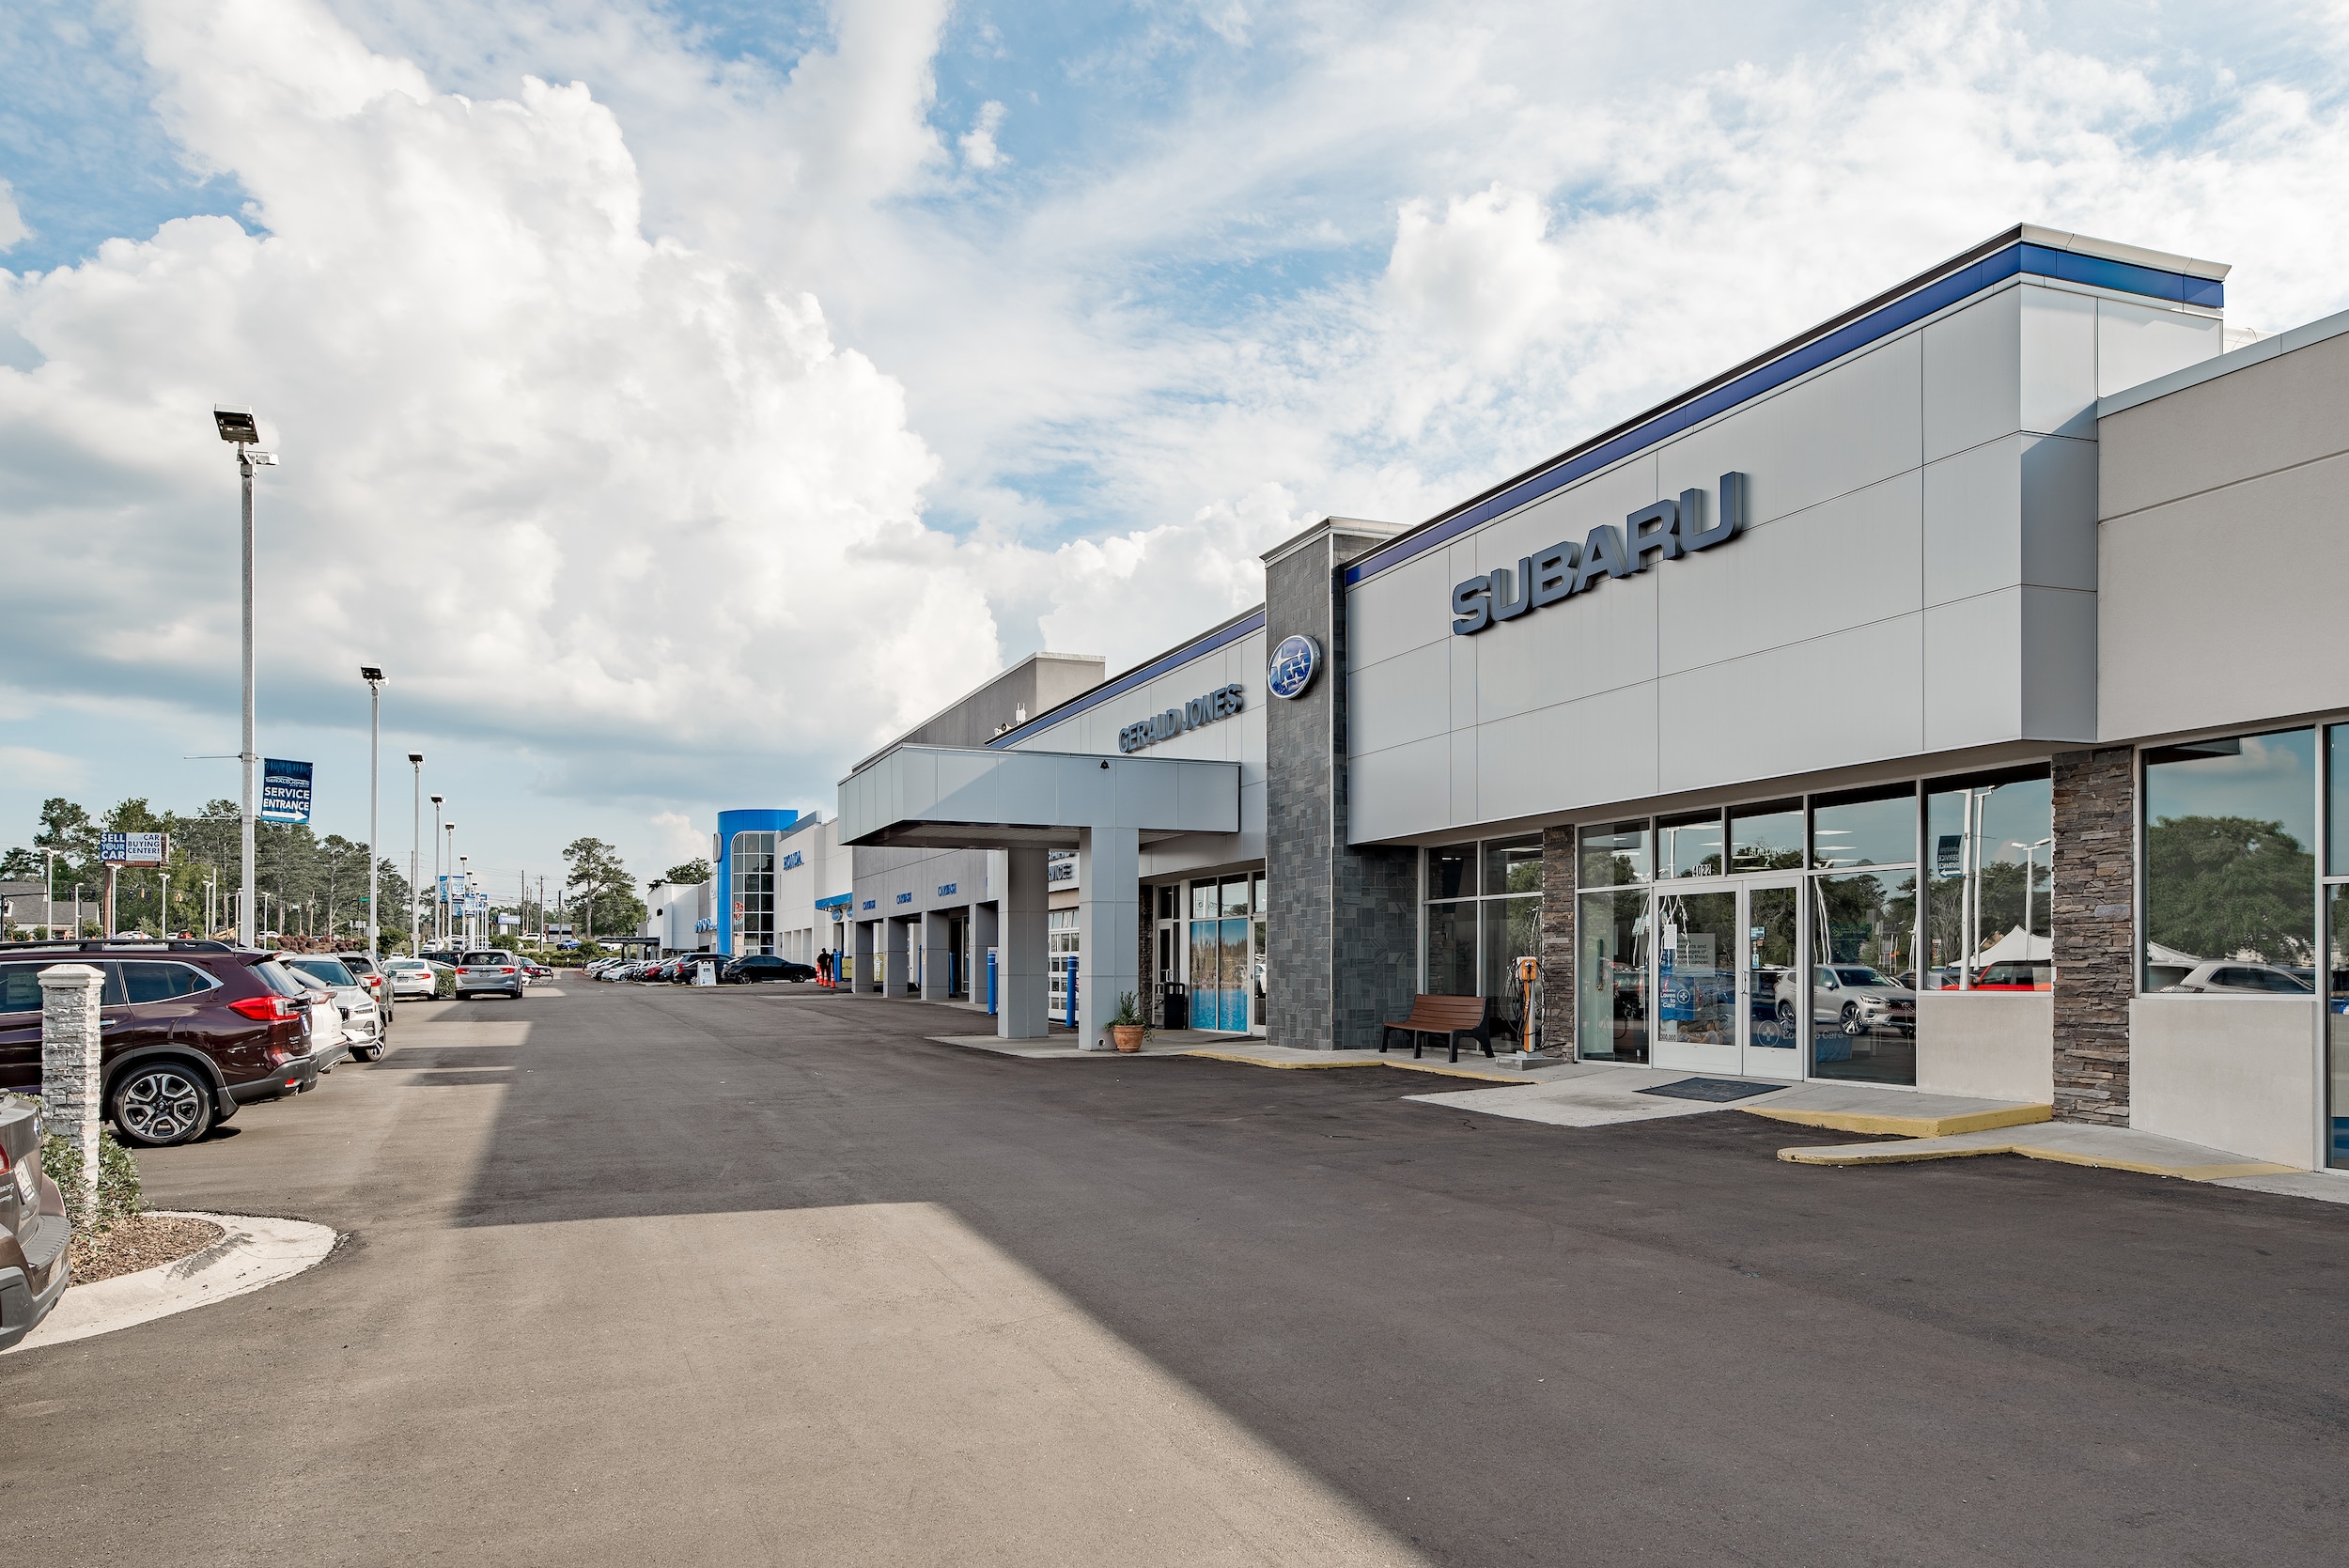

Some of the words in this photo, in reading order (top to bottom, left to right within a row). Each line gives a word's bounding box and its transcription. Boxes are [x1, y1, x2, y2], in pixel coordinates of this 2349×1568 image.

[1452, 471, 1744, 636] SUBARU
[1118, 708, 1182, 753] GERALD
[1182, 683, 1243, 731] JONES
[264, 786, 310, 800] SERVICE
[263, 798, 310, 811] ENTRANCE
[101, 843, 125, 851] YOUR
[1749, 846, 1786, 857] BUILDING
[101, 850, 125, 860] CAR
[1764, 857, 1770, 867] 2
[1692, 864, 1711, 877] 4022
[1822, 1030, 1843, 1040] Care
